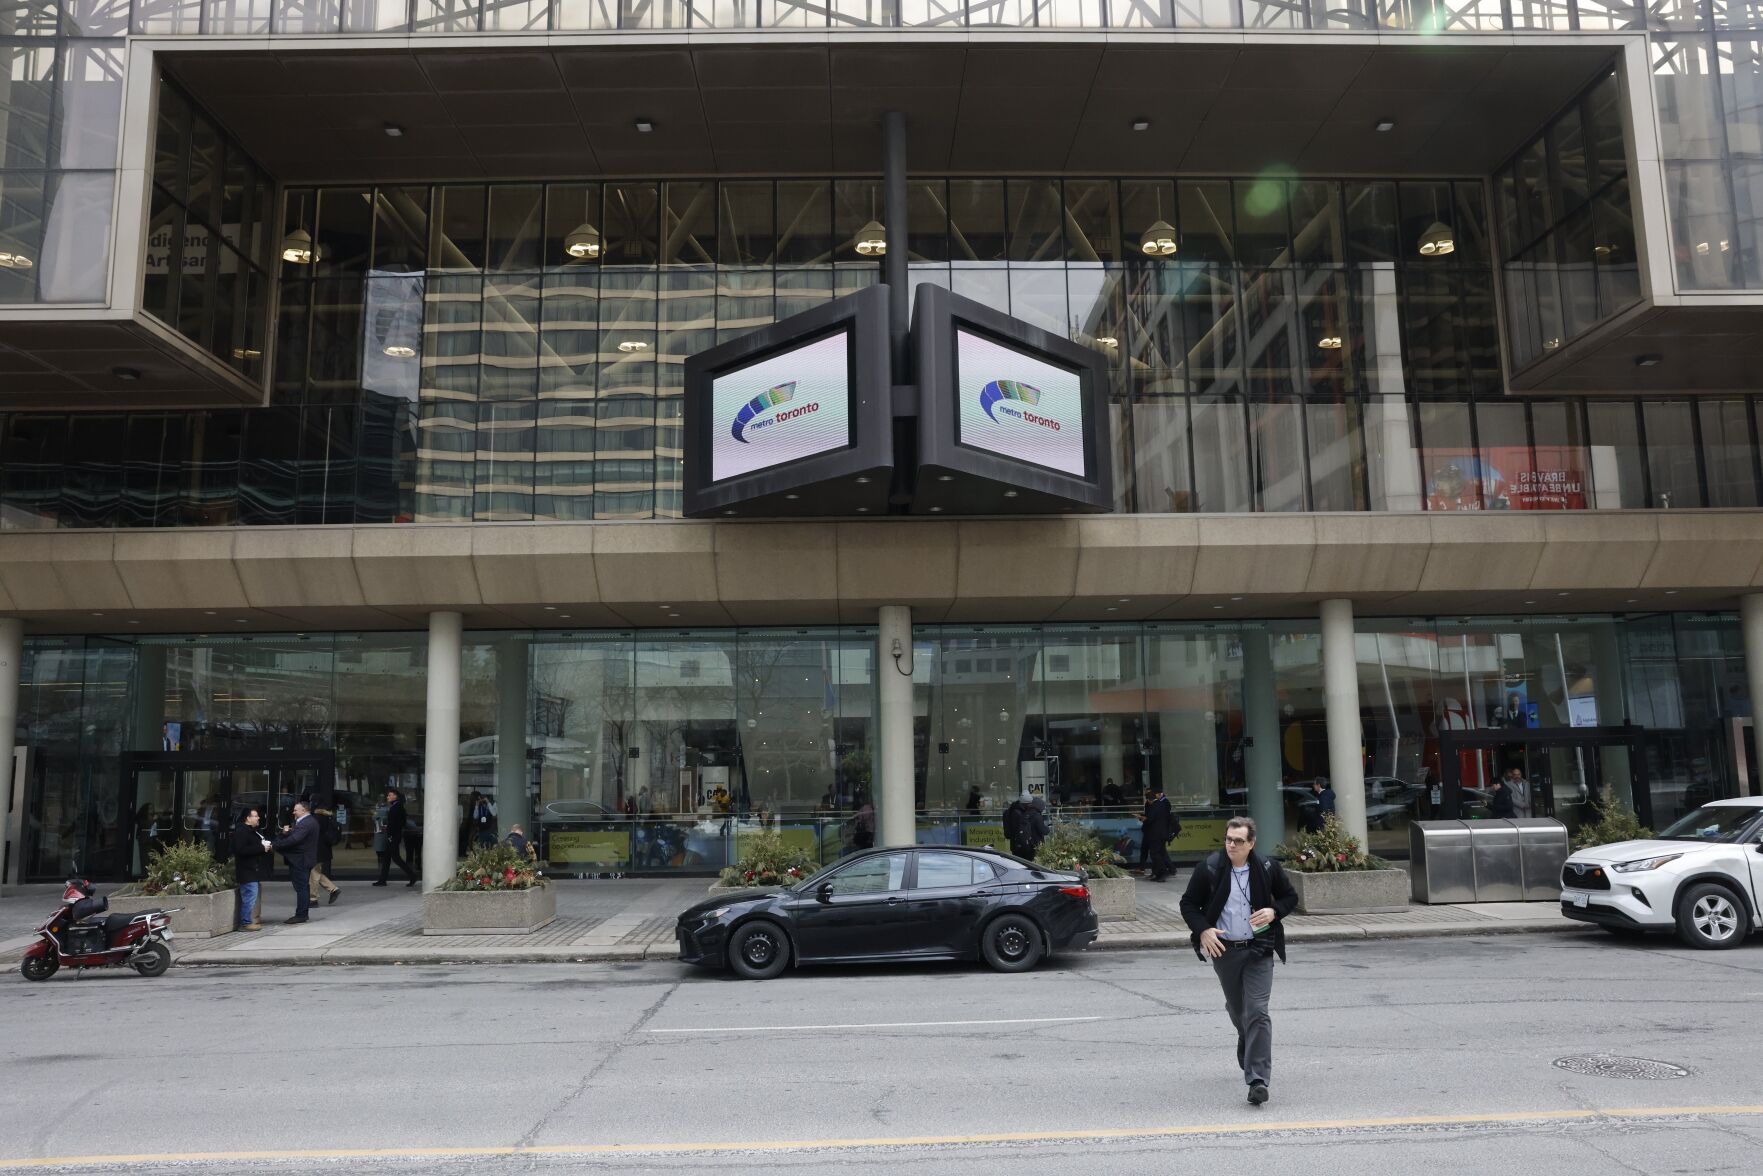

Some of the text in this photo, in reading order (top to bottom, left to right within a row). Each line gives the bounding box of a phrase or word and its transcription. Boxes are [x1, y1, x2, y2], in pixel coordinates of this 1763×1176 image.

[751, 402, 819, 430] metro toronto
[1000, 406, 1061, 431] metro toronto
[1028, 783, 1045, 794] CAT
